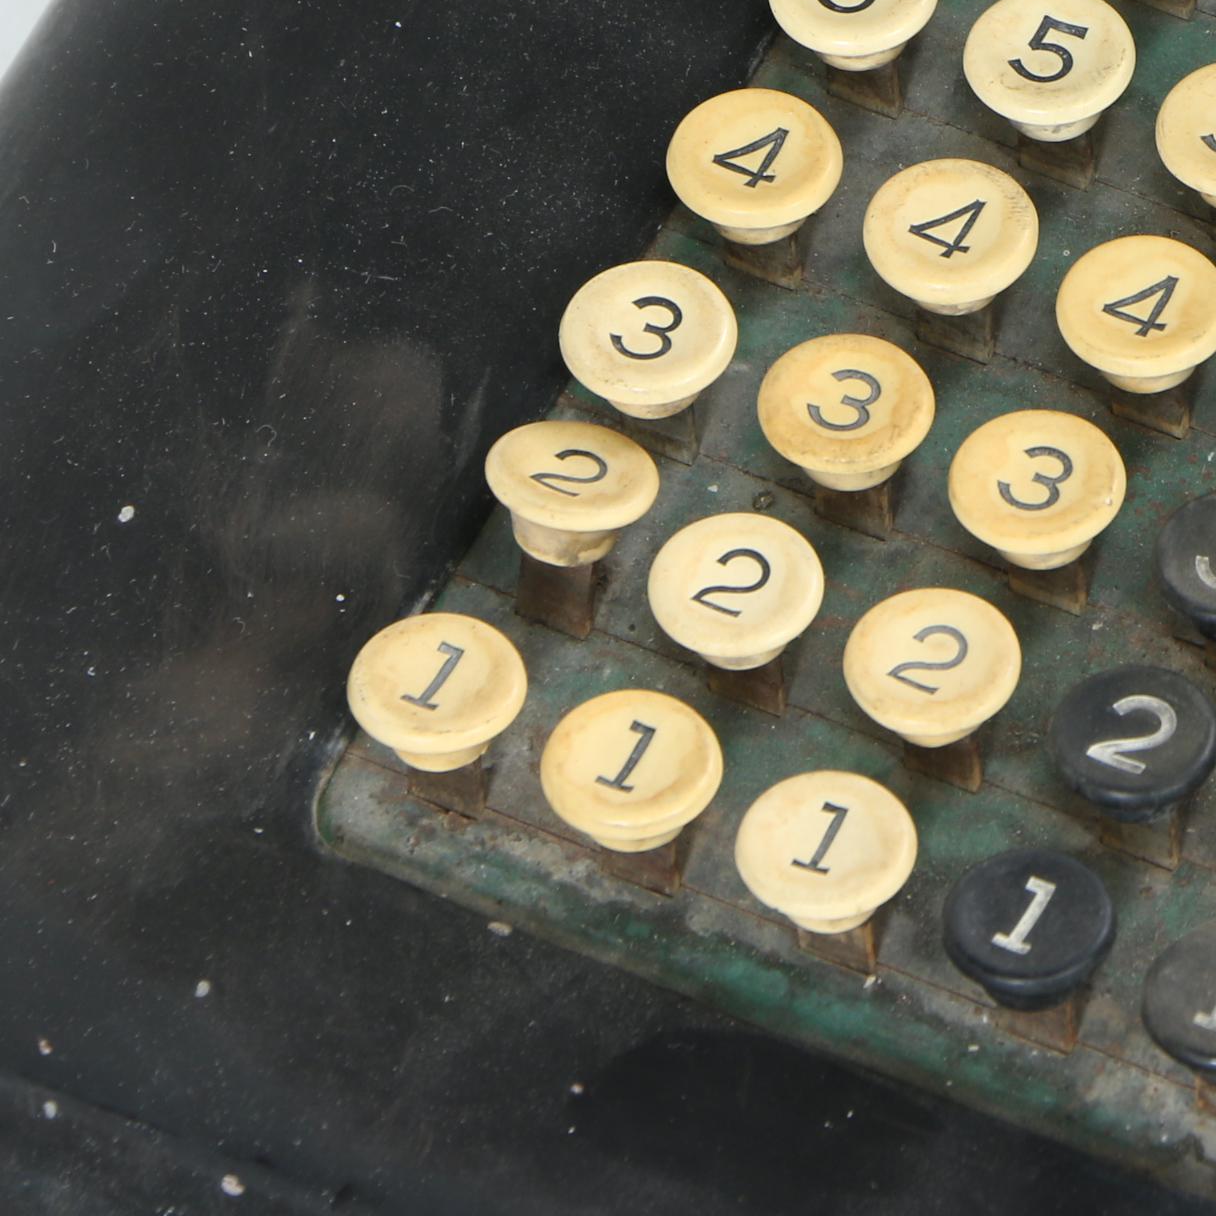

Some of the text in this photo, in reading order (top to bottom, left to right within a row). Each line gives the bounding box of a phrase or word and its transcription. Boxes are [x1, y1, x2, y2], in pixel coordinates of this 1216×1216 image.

[1008, 15, 1085, 83] 5
[712, 128, 787, 188] 4
[909, 200, 983, 258] 4
[610, 296, 683, 360] 3
[1102, 276, 1176, 337] 4
[807, 369, 882, 431] 3
[530, 449, 607, 497] 2
[997, 446, 1073, 511] 3
[693, 548, 771, 617] 2
[401, 641, 465, 711] 1
[890, 625, 969, 695] 2
[596, 720, 656, 792] 1
[1091, 695, 1172, 773] 2
[791, 802, 848, 875] 1
[993, 876, 1055, 953] 1
